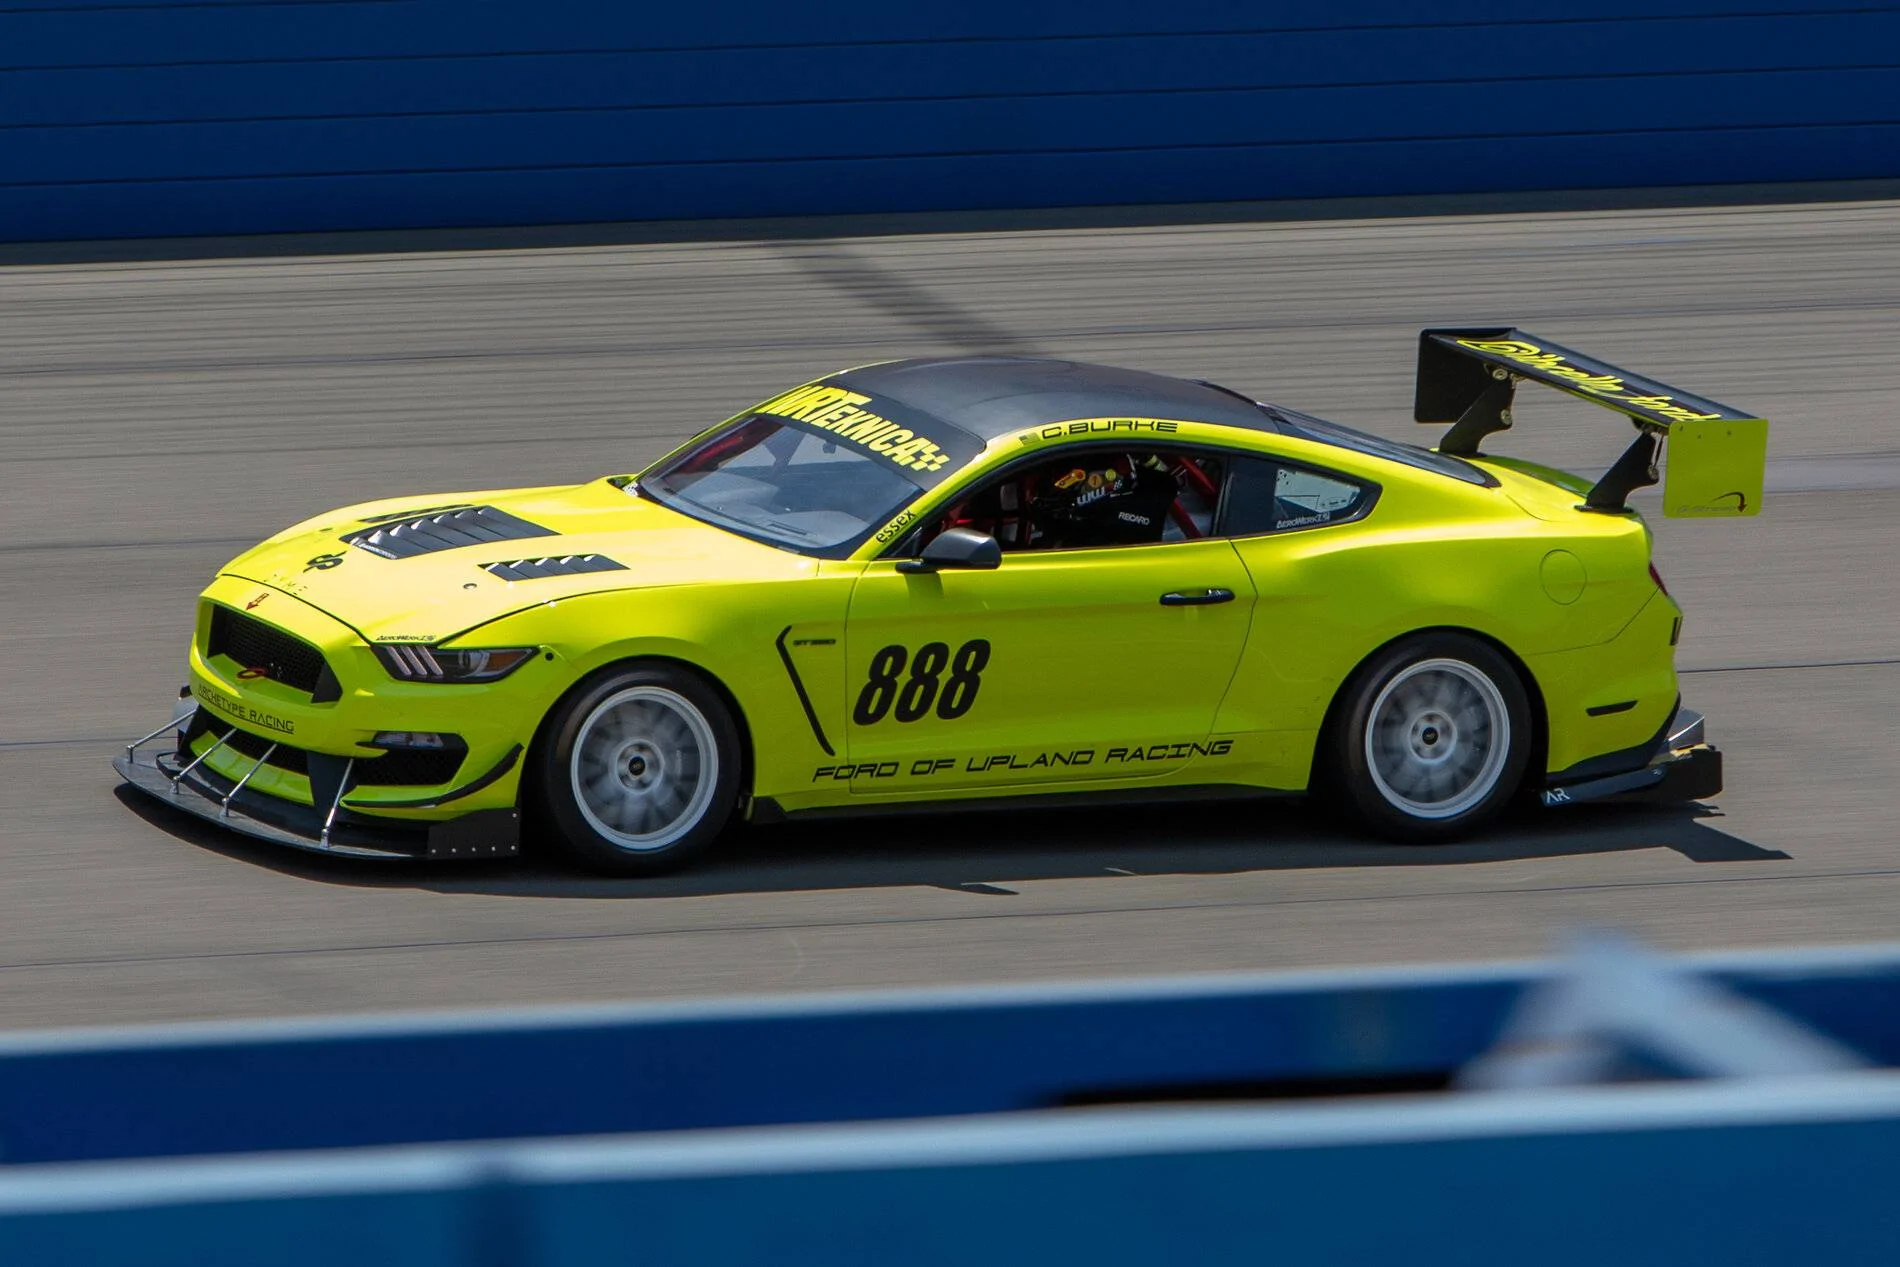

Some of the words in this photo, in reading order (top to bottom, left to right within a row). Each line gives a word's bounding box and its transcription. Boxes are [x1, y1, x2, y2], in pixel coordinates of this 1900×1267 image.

[1042, 420, 1178, 440] C.BURKE
[876, 511, 916, 543] essex
[853, 639, 991, 726] 888
[249, 709, 295, 732] RACING
[812, 761, 899, 782] FORD
[910, 758, 956, 776] OF
[965, 750, 1095, 773] UPLAND
[1104, 739, 1234, 764] RACING
